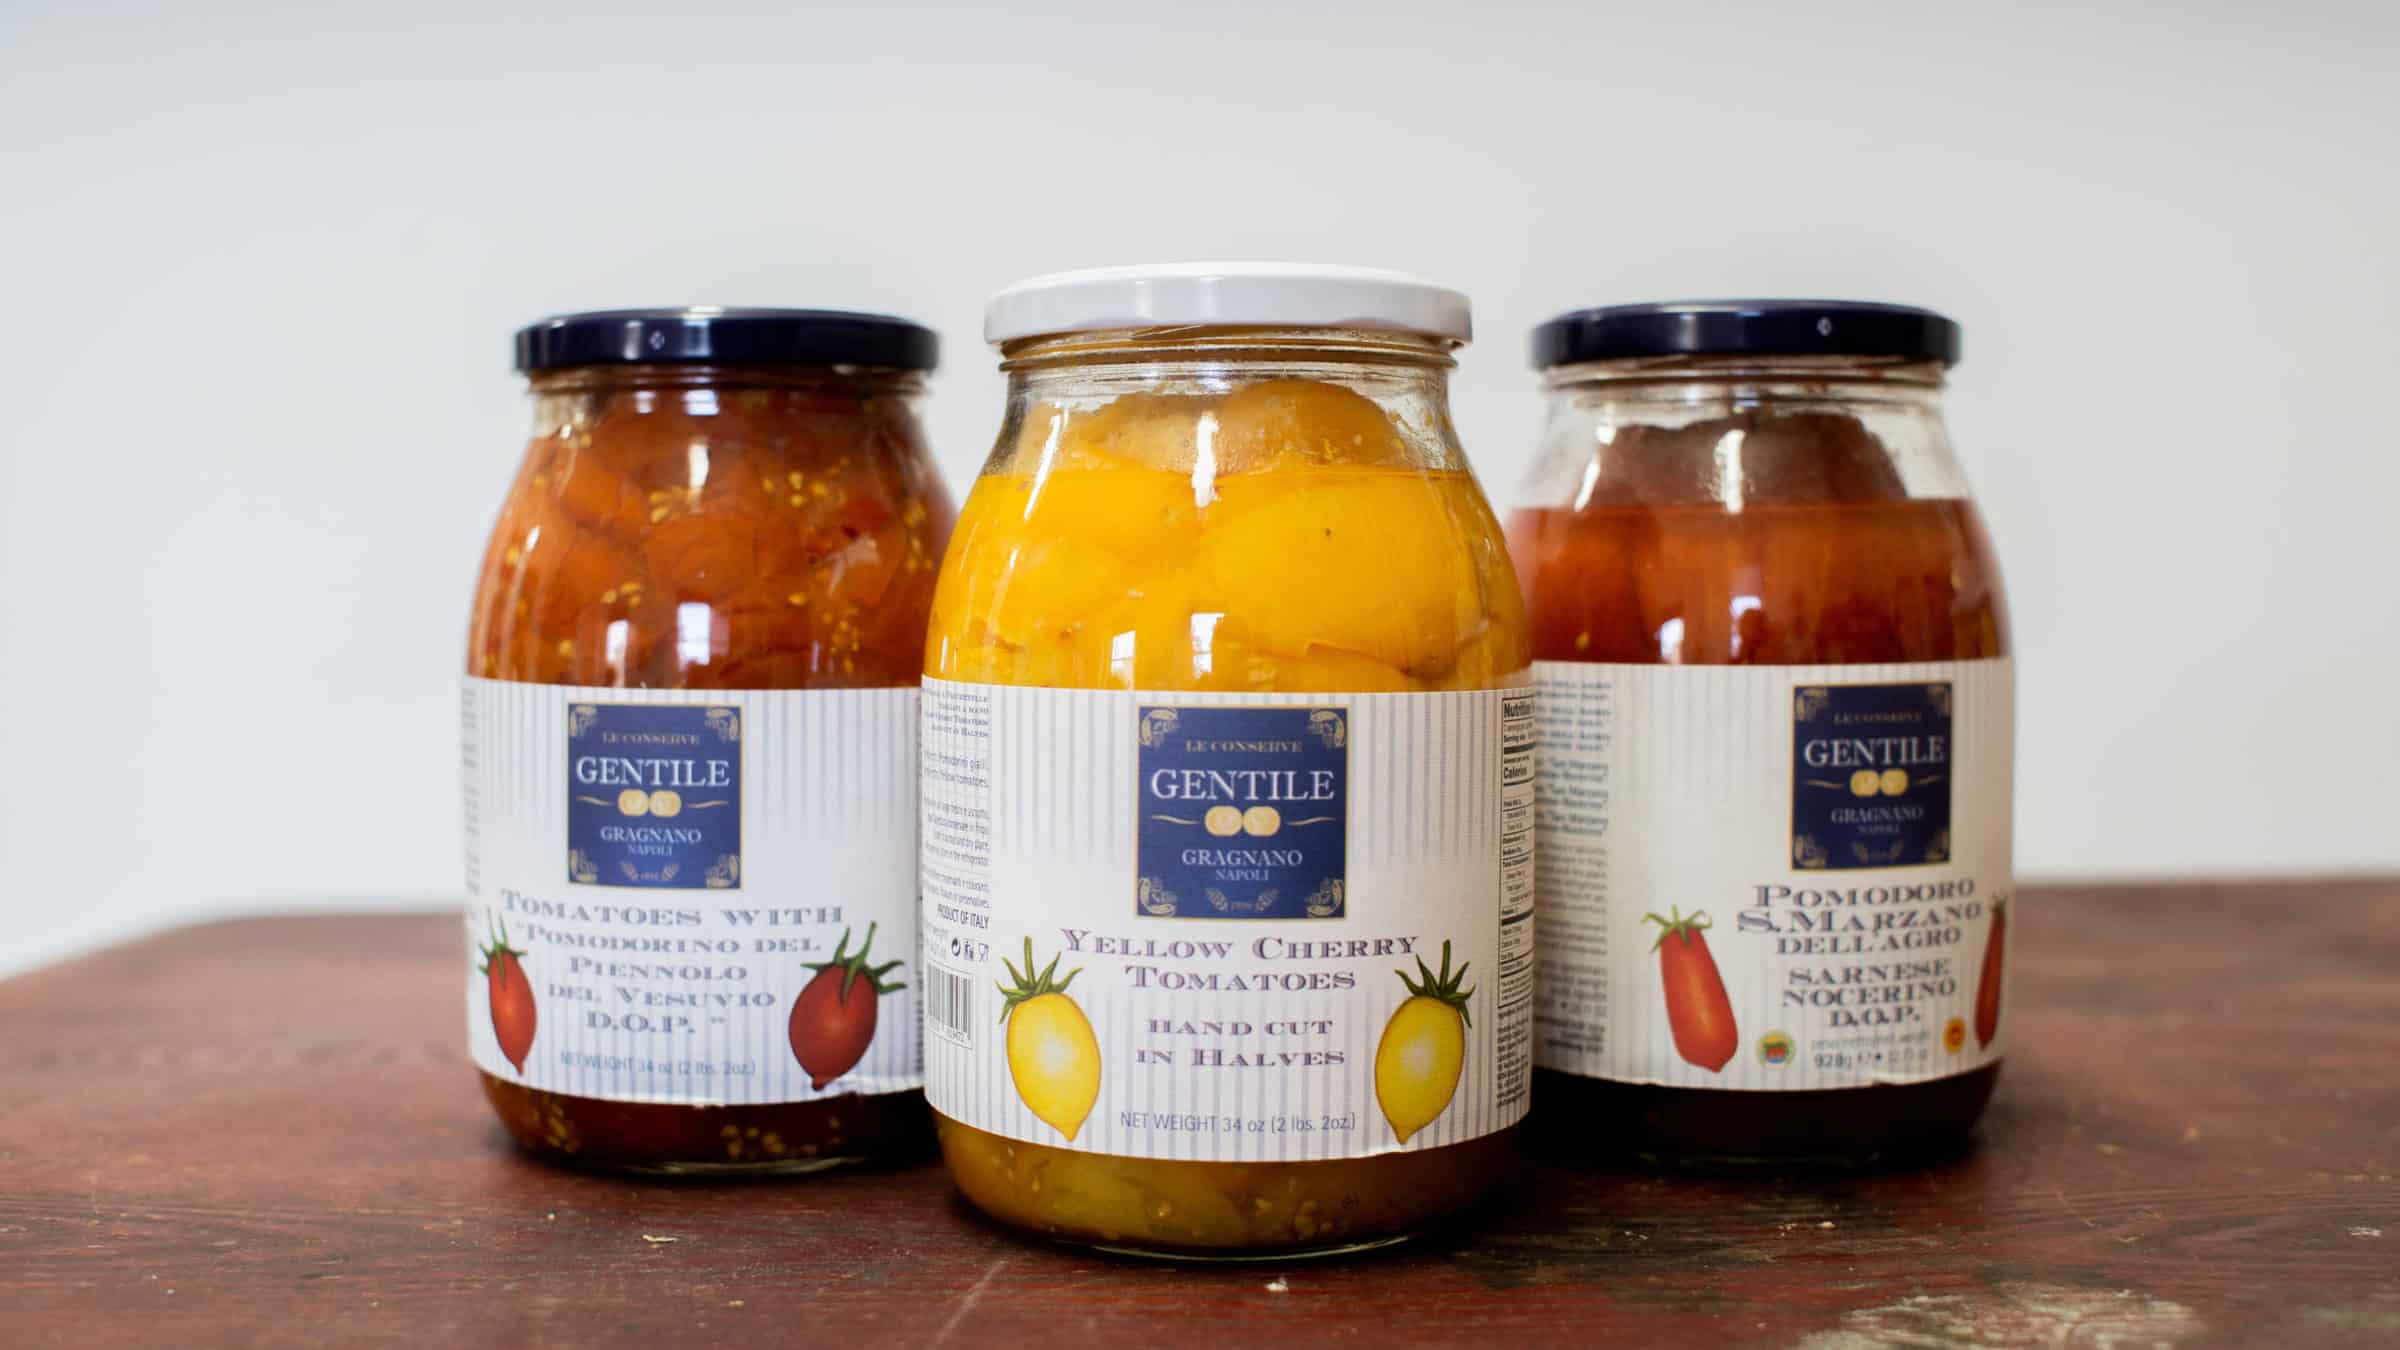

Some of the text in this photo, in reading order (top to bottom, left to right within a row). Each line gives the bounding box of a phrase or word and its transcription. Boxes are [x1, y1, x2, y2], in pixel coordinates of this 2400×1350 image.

[602, 731, 620, 744] LE
[1186, 740, 1303, 753] LE CONSERVE
[1804, 736, 1944, 768] GENTILE
[576, 756, 730, 787] GENTILE
[1151, 768, 1335, 801] GENTILE
[1830, 806, 1924, 825] GRAGNANO
[601, 826, 702, 844] GRAGNANO
[1181, 849, 1303, 867] GRAGNANO
[1216, 869, 1269, 881] NAPOLI
[969, 912, 989, 929] ITALY
[1789, 959, 1950, 985] SARNESE
[1782, 978, 1956, 1008] NOCERINO
[1147, 1019, 1333, 1036] HAND CUT
[1135, 1049, 1172, 1066] IN
[1120, 1112, 1149, 1129] NET
[1153, 1113, 1217, 1132] WEIGHT
[1223, 1117, 1241, 1132] 34
[1247, 1120, 1265, 1132] oz
[1271, 1115, 1286, 1134] (2
